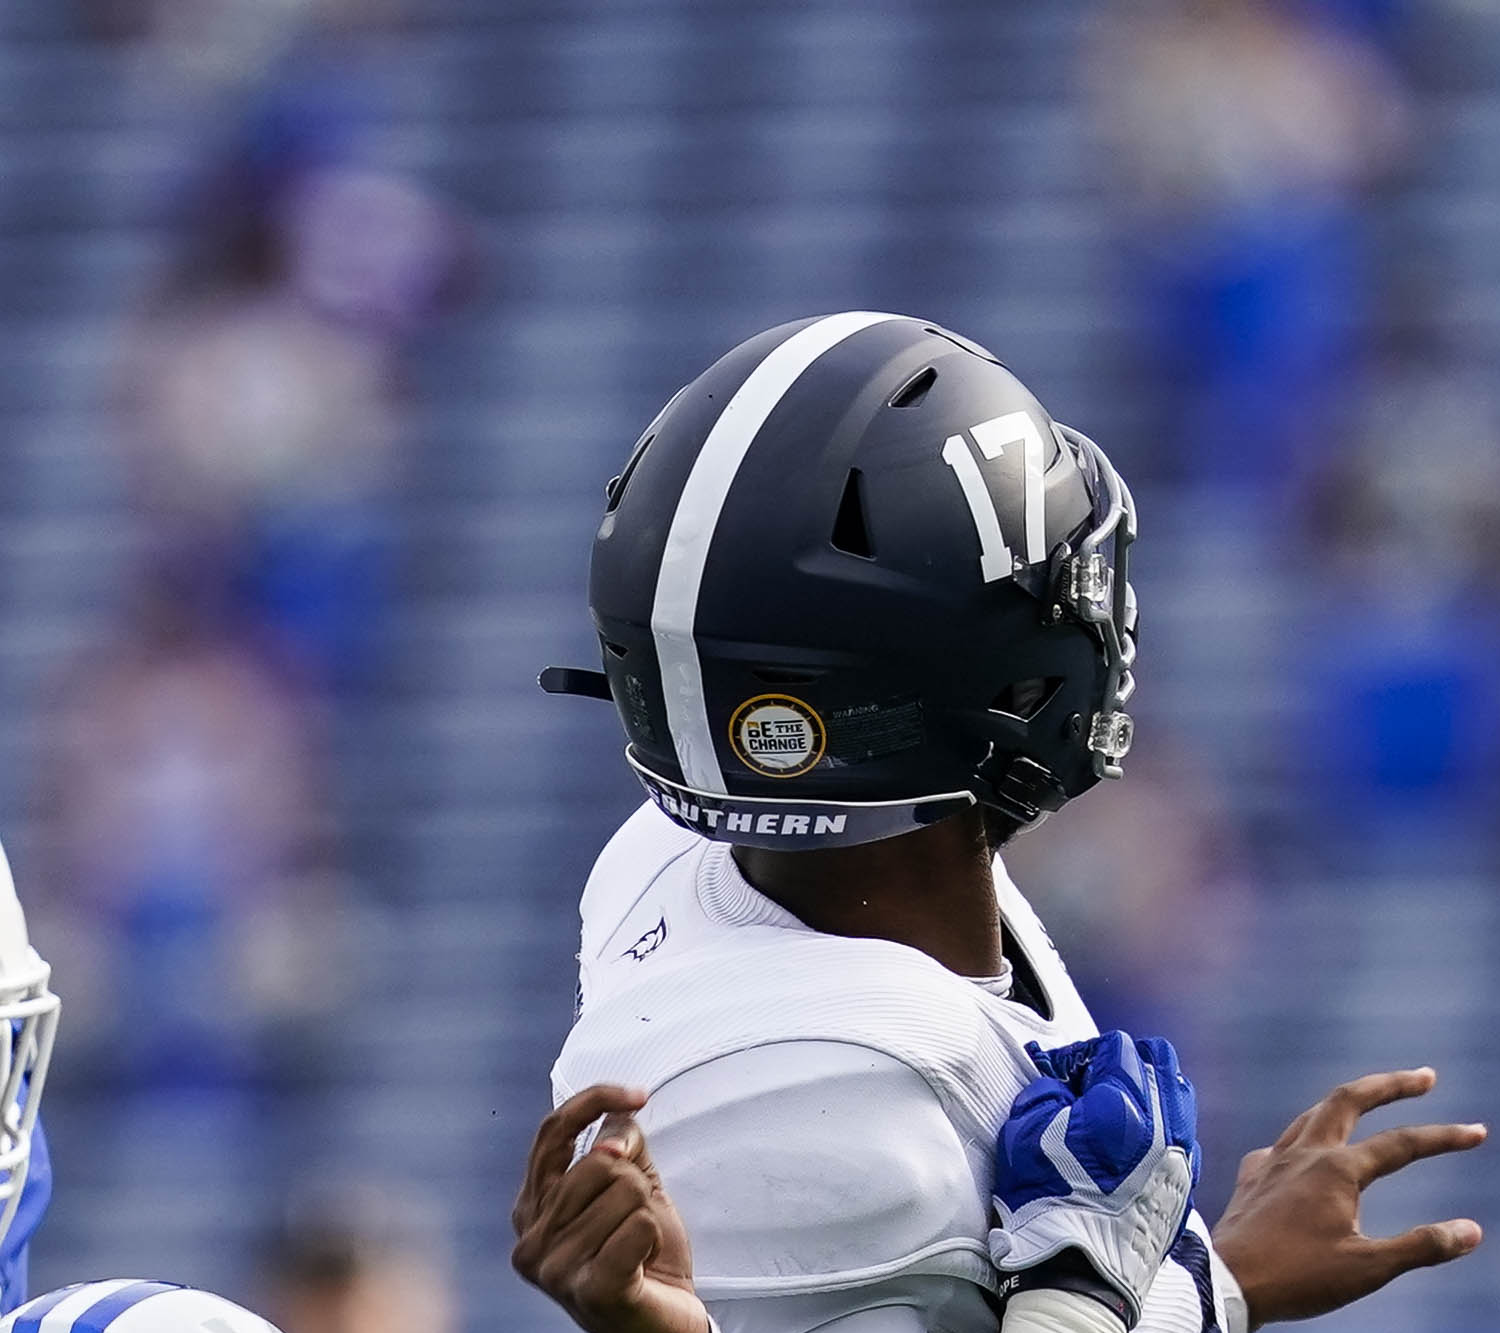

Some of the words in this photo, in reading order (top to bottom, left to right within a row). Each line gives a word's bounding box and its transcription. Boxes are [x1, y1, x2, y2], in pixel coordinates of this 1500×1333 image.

[941, 411, 1045, 583] 17
[747, 720, 774, 738] BE
[775, 723, 804, 734] THE
[749, 737, 807, 751] CHANGE
